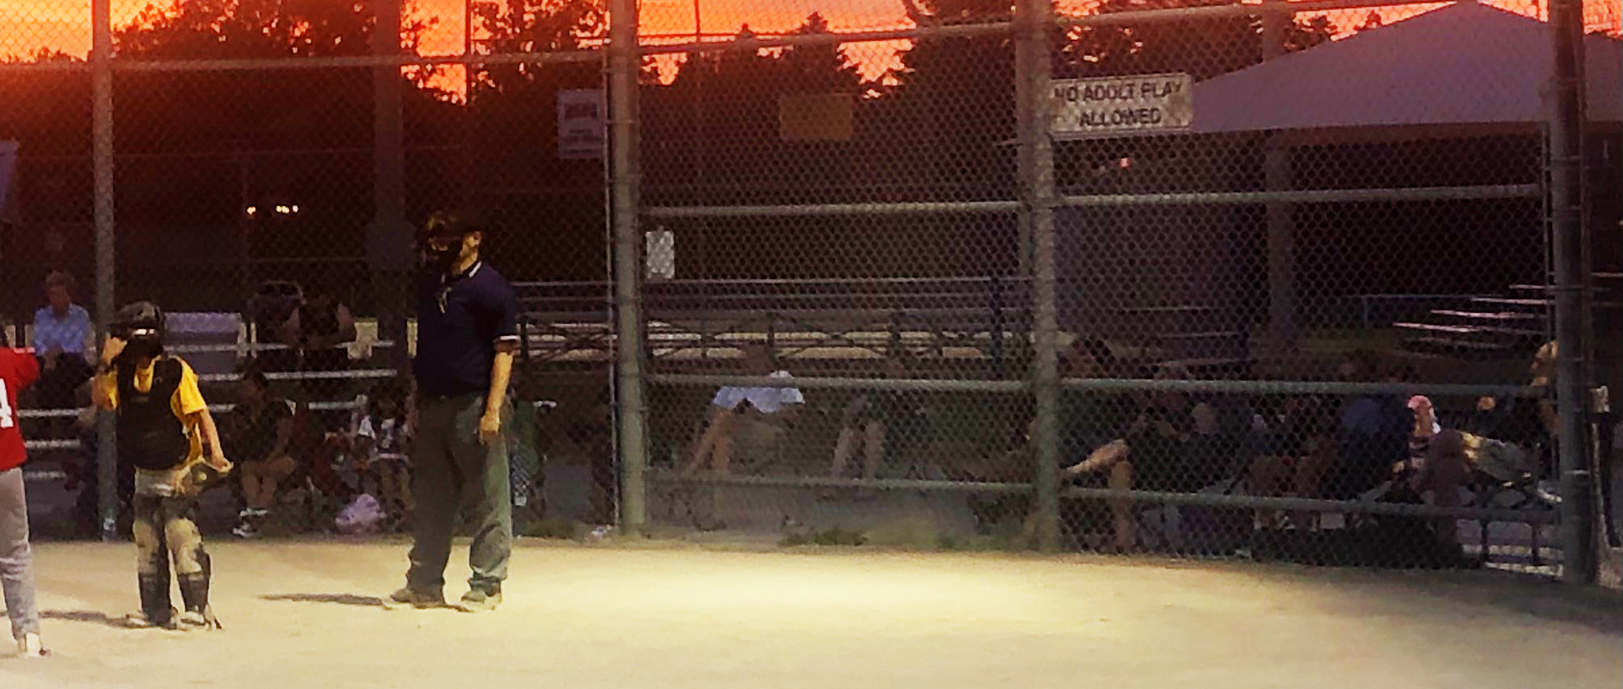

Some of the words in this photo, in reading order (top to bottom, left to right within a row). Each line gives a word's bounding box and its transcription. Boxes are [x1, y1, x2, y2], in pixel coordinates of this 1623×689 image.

[1053, 86, 1078, 102] NO
[1083, 83, 1135, 101] ADULT
[1140, 81, 1182, 98] PLAY
[1079, 107, 1162, 126] ALLOWED
